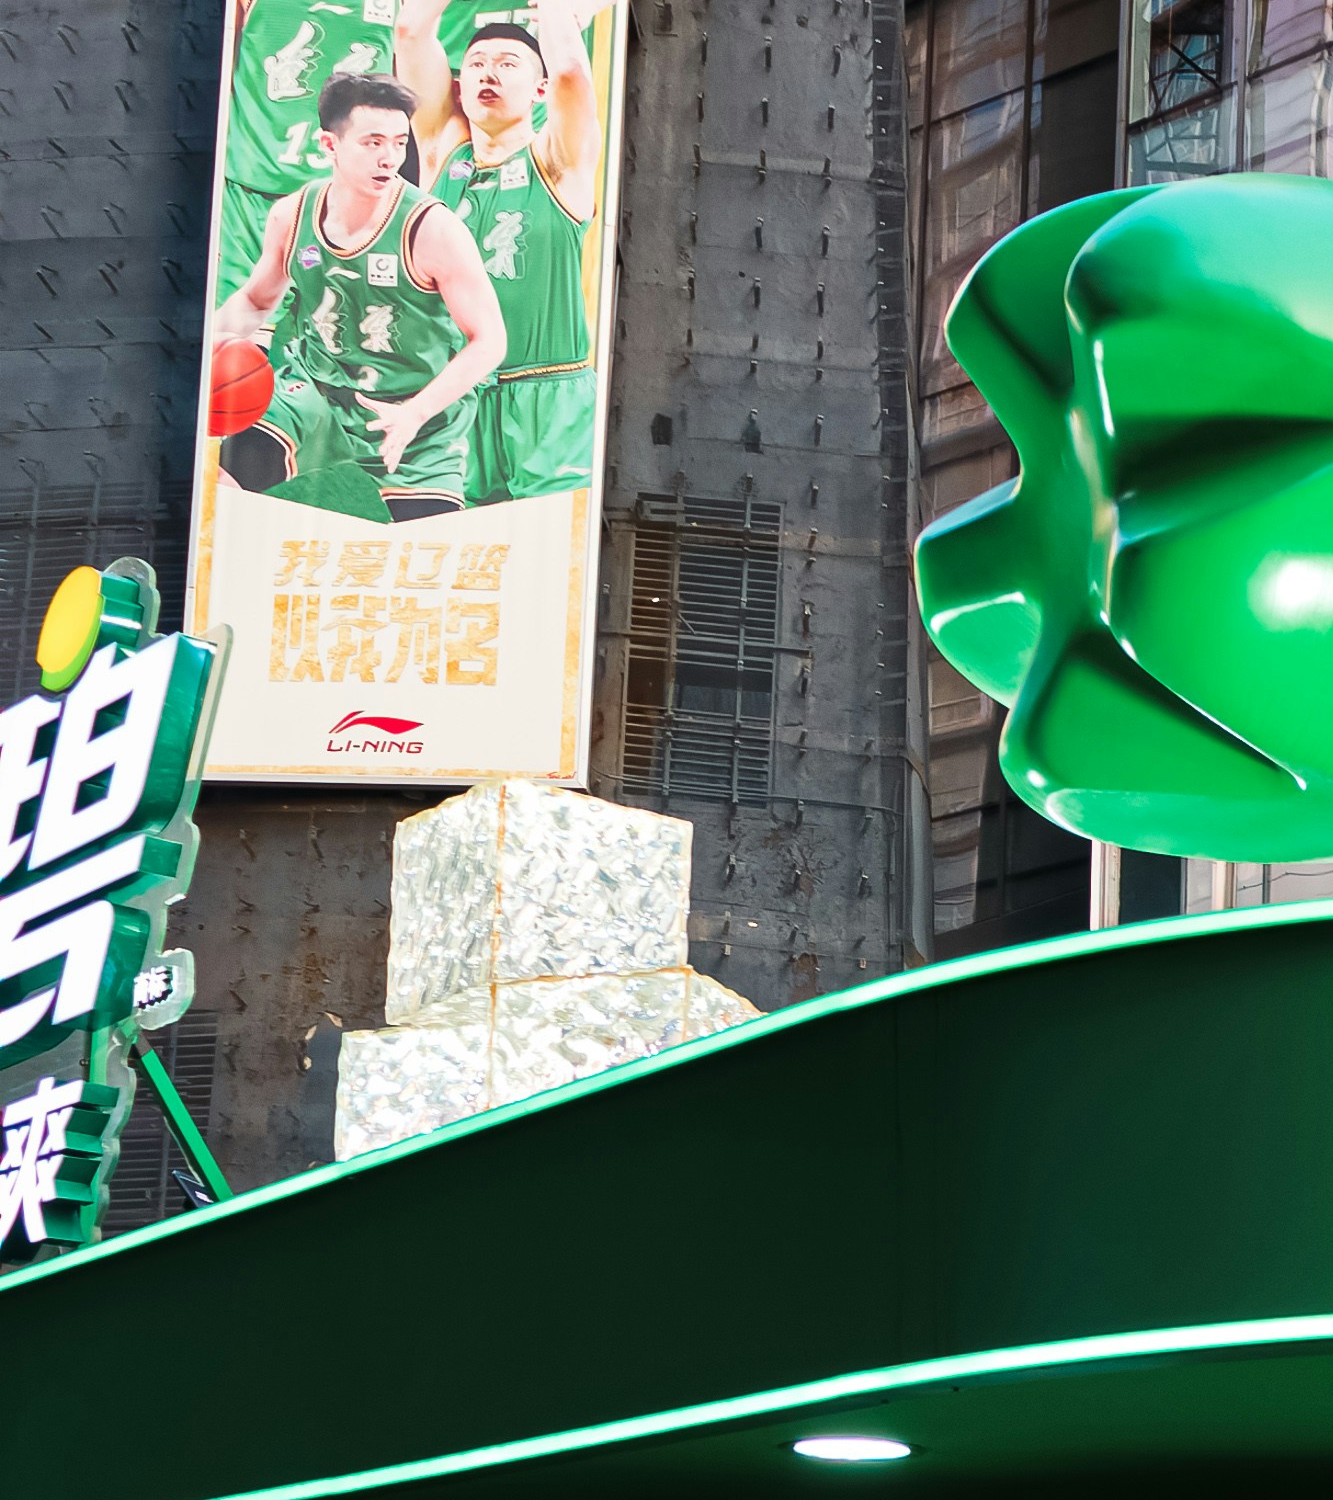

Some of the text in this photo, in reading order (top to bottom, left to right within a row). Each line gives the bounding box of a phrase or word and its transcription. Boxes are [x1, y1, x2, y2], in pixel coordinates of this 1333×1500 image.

[273, 539, 511, 591] 我爱辽篮
[326, 739, 425, 754] LI-NING
